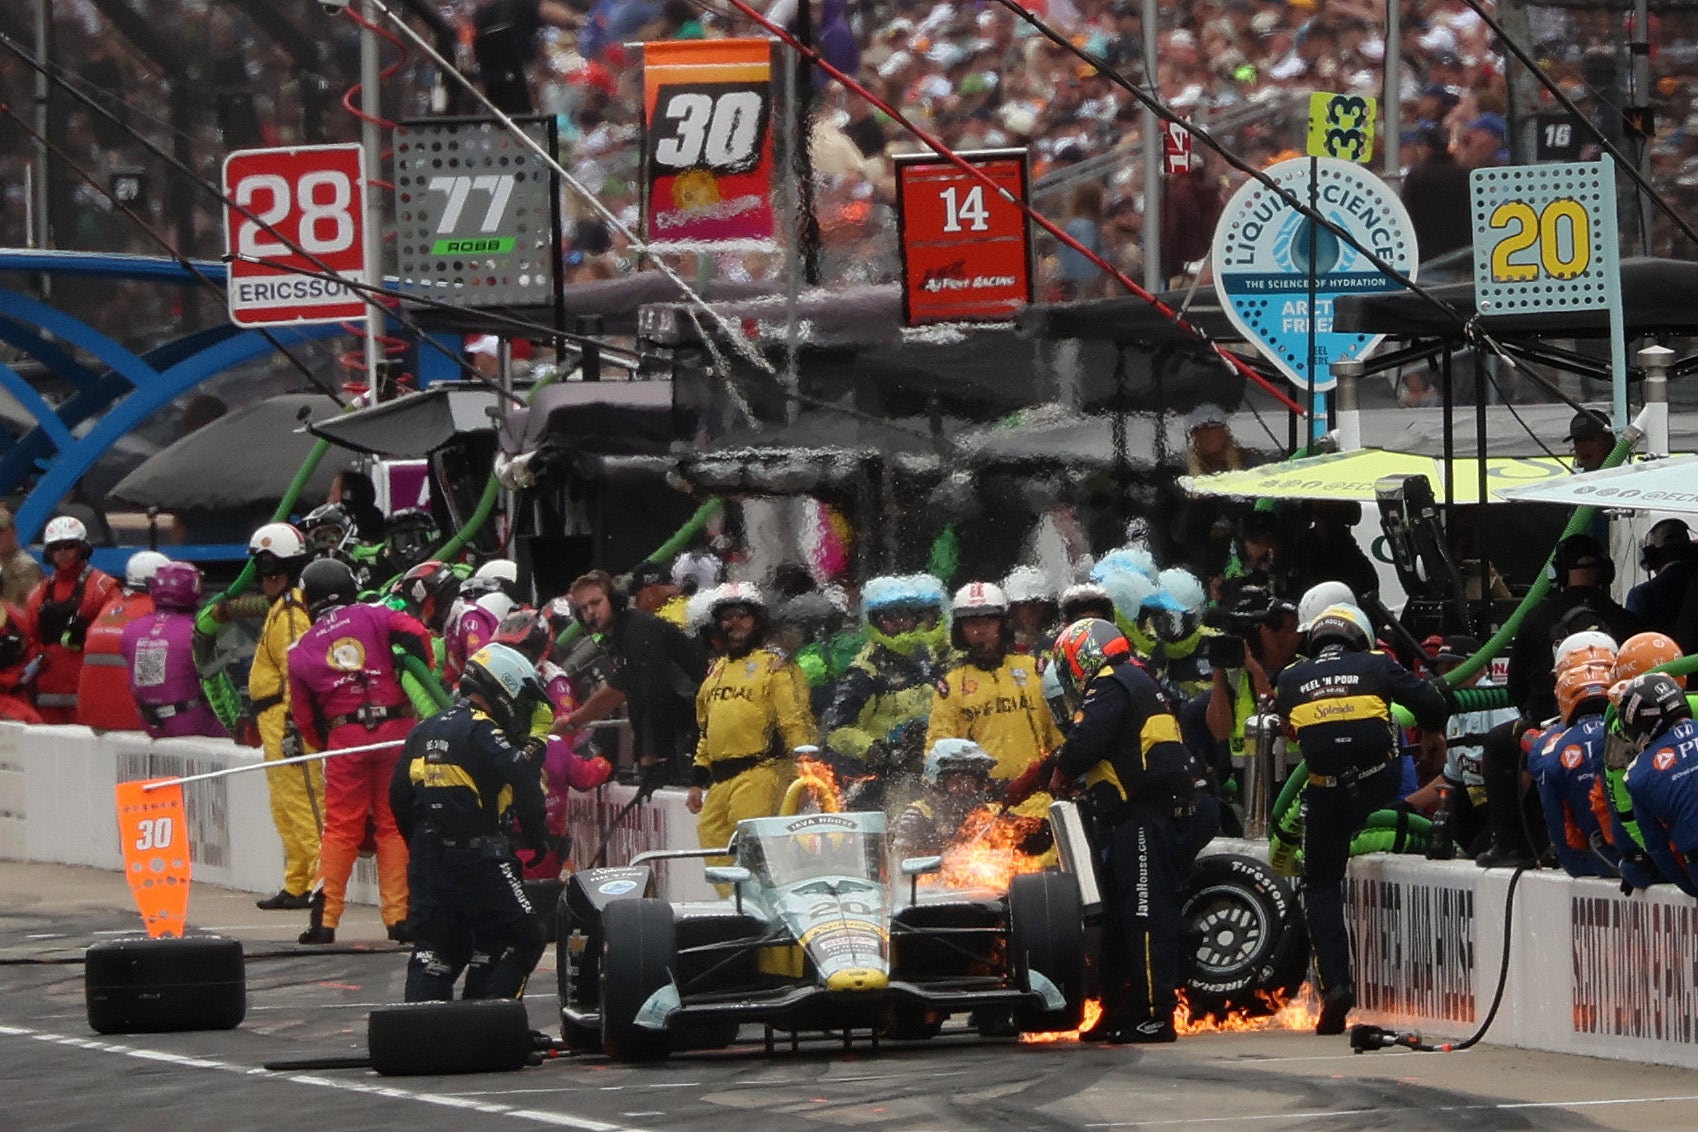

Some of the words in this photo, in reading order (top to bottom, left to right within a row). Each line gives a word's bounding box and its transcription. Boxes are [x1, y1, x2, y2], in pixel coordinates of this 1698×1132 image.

[655, 91, 763, 170] 30
[1325, 95, 1368, 160] 33
[1545, 124, 1571, 147] 16
[236, 170, 354, 257] 28
[428, 175, 515, 233] 77
[940, 186, 989, 232] 14
[1237, 187, 1297, 265] LIQUID
[1489, 198, 1590, 283] 20
[1245, 280, 1265, 289] THE
[1268, 280, 1308, 289] SCIENCE
[1314, 279, 1327, 288] OF
[1330, 278, 1386, 288] HYDRATION
[1281, 300, 1332, 315] ARCT
[1300, 679, 1321, 694] PEEL
[1335, 674, 1360, 685] POUR
[135, 817, 173, 850] 30
[809, 901, 873, 920] 20
[1404, 884, 1434, 1017] JAVA
[1435, 887, 1474, 1023] HOUSE
[1572, 897, 1610, 1035] SCOTT
[1613, 899, 1651, 1038] DIXON
[1664, 904, 1690, 1043] PNC
[1187, 976, 1251, 992] FIREHA
